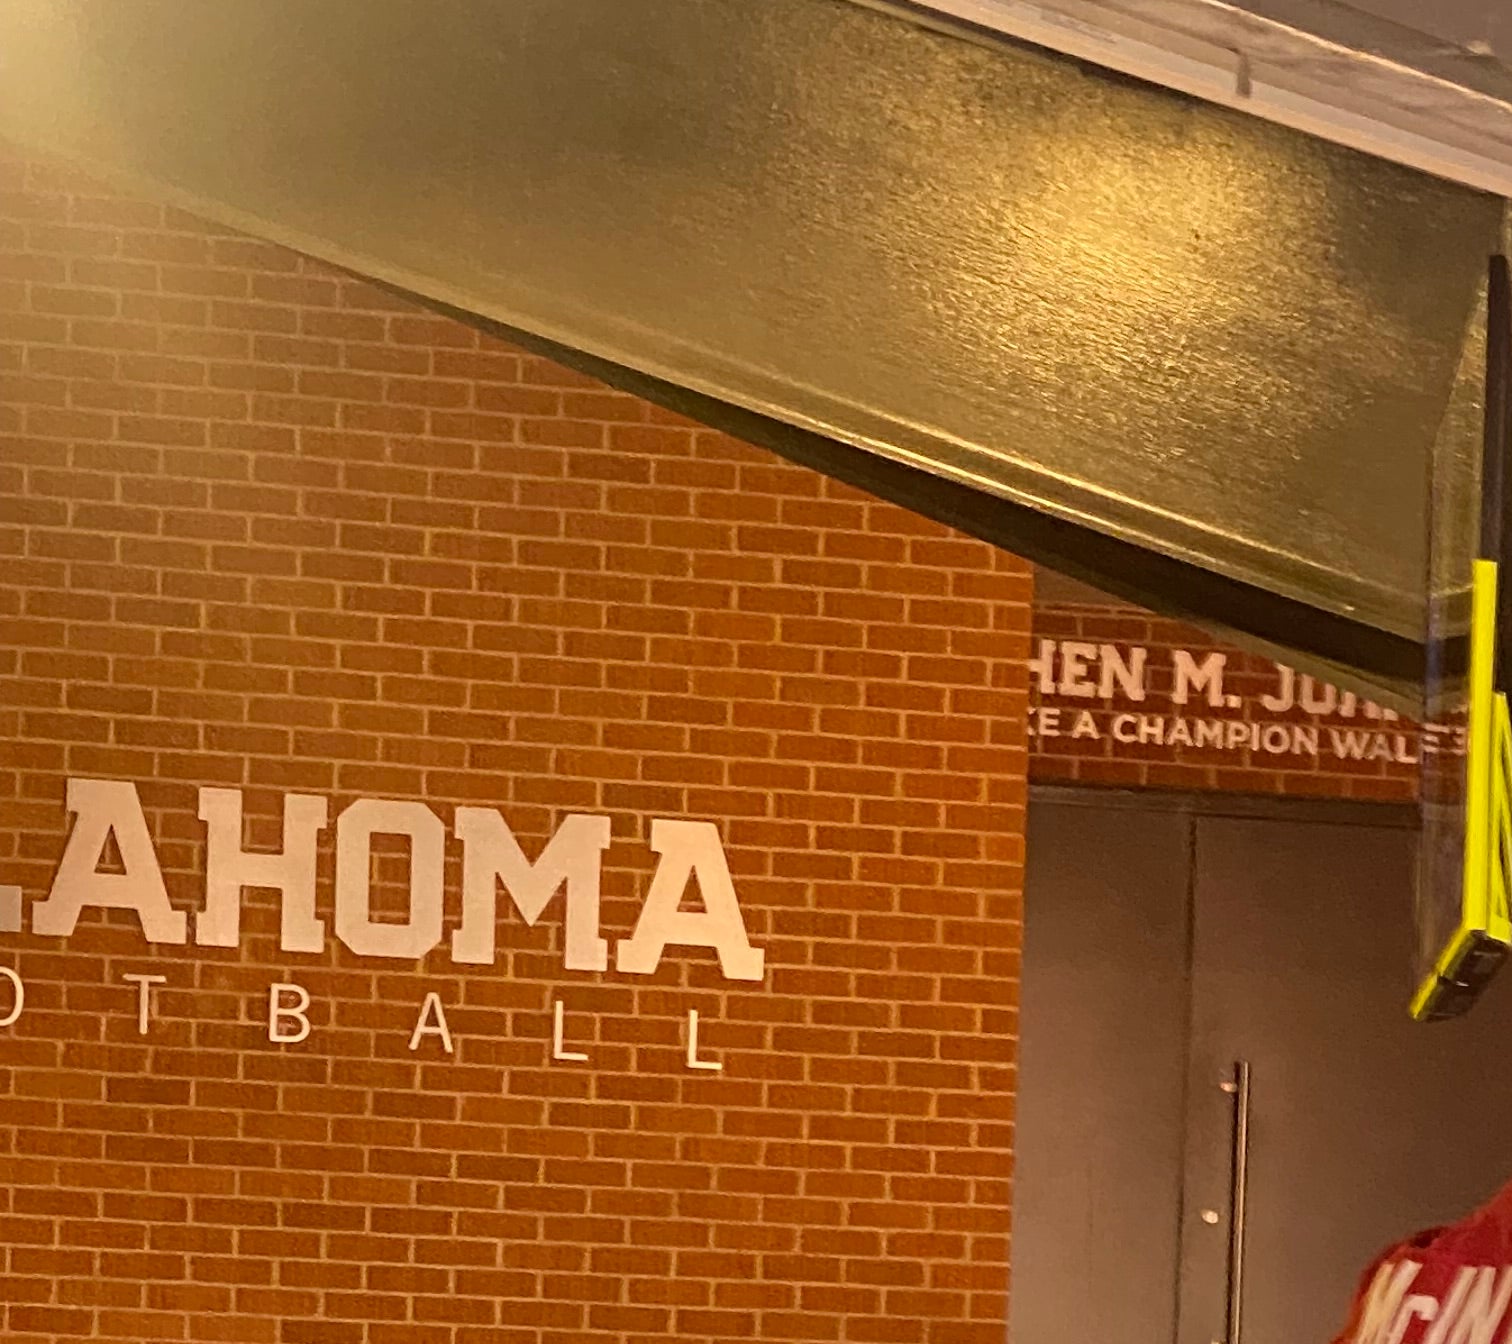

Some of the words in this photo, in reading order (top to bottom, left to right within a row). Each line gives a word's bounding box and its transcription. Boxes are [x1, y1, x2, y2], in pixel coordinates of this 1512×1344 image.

[1171, 650, 1241, 709] M.
[1072, 710, 1101, 740] A
[1112, 713, 1318, 756] CHAMPION
[0, 778, 765, 982] AHOMA
